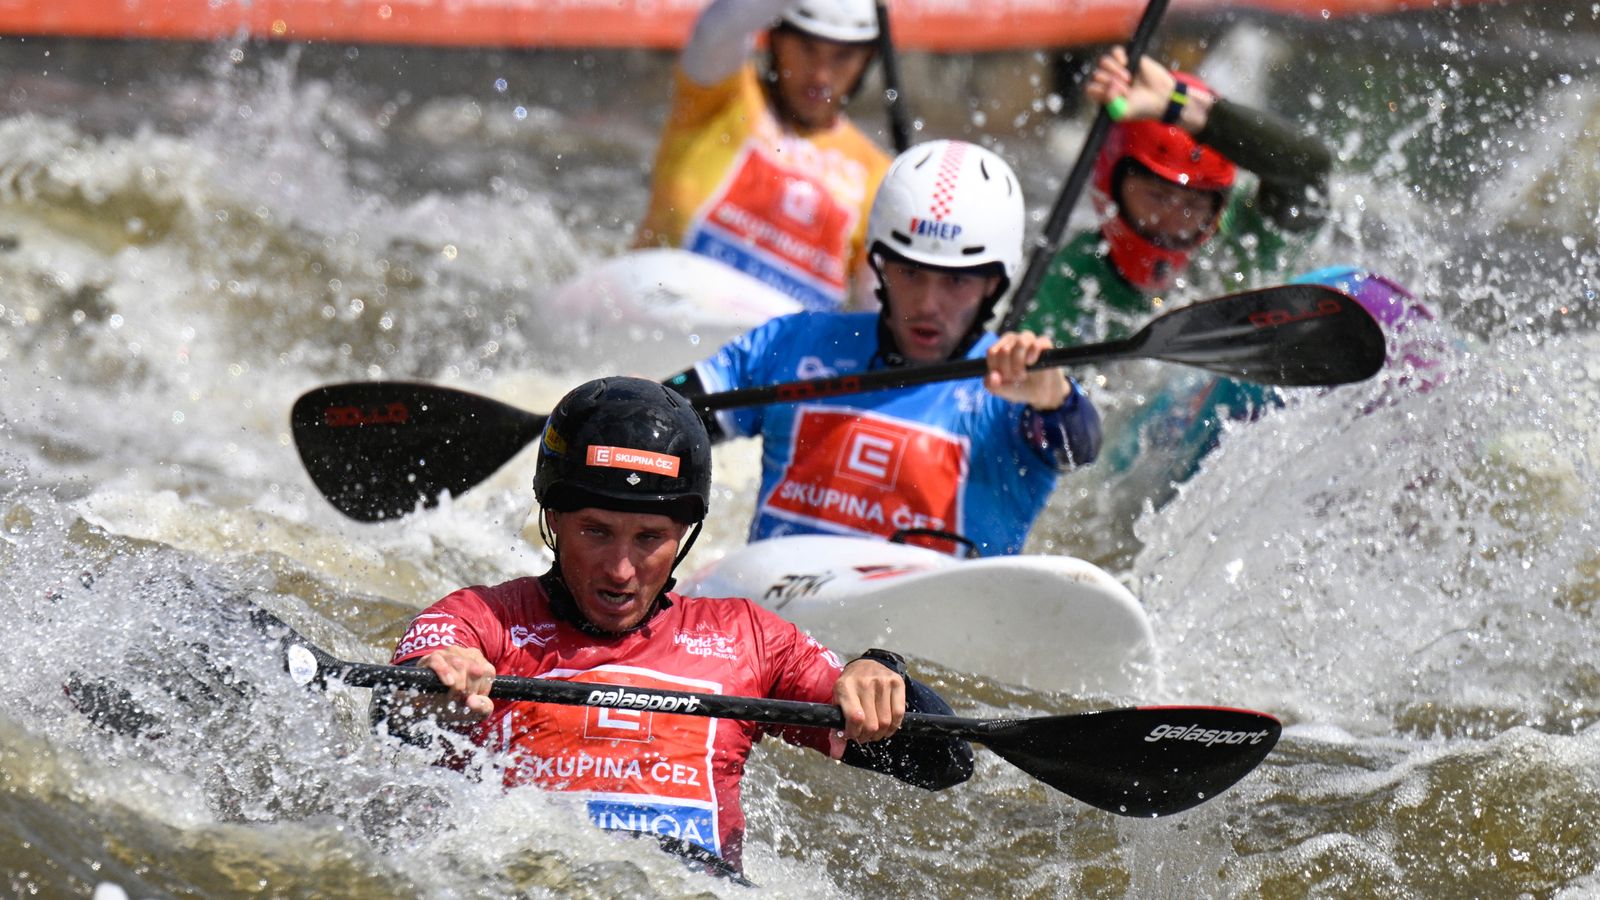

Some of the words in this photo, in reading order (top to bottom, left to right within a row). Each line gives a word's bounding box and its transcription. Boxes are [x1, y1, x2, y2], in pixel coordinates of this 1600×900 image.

[615, 453, 654, 467] SKUPINA
[656, 458, 673, 470] ČEZ
[779, 480, 885, 525] SKUPINA
[402, 623, 457, 643] AYAK
[674, 633, 711, 648] World
[687, 646, 712, 658] Cup
[587, 688, 701, 713] galasport
[1145, 724, 1269, 747] galasport
[519, 755, 643, 780] SKUPINA
[651, 757, 701, 787] ČEZ
